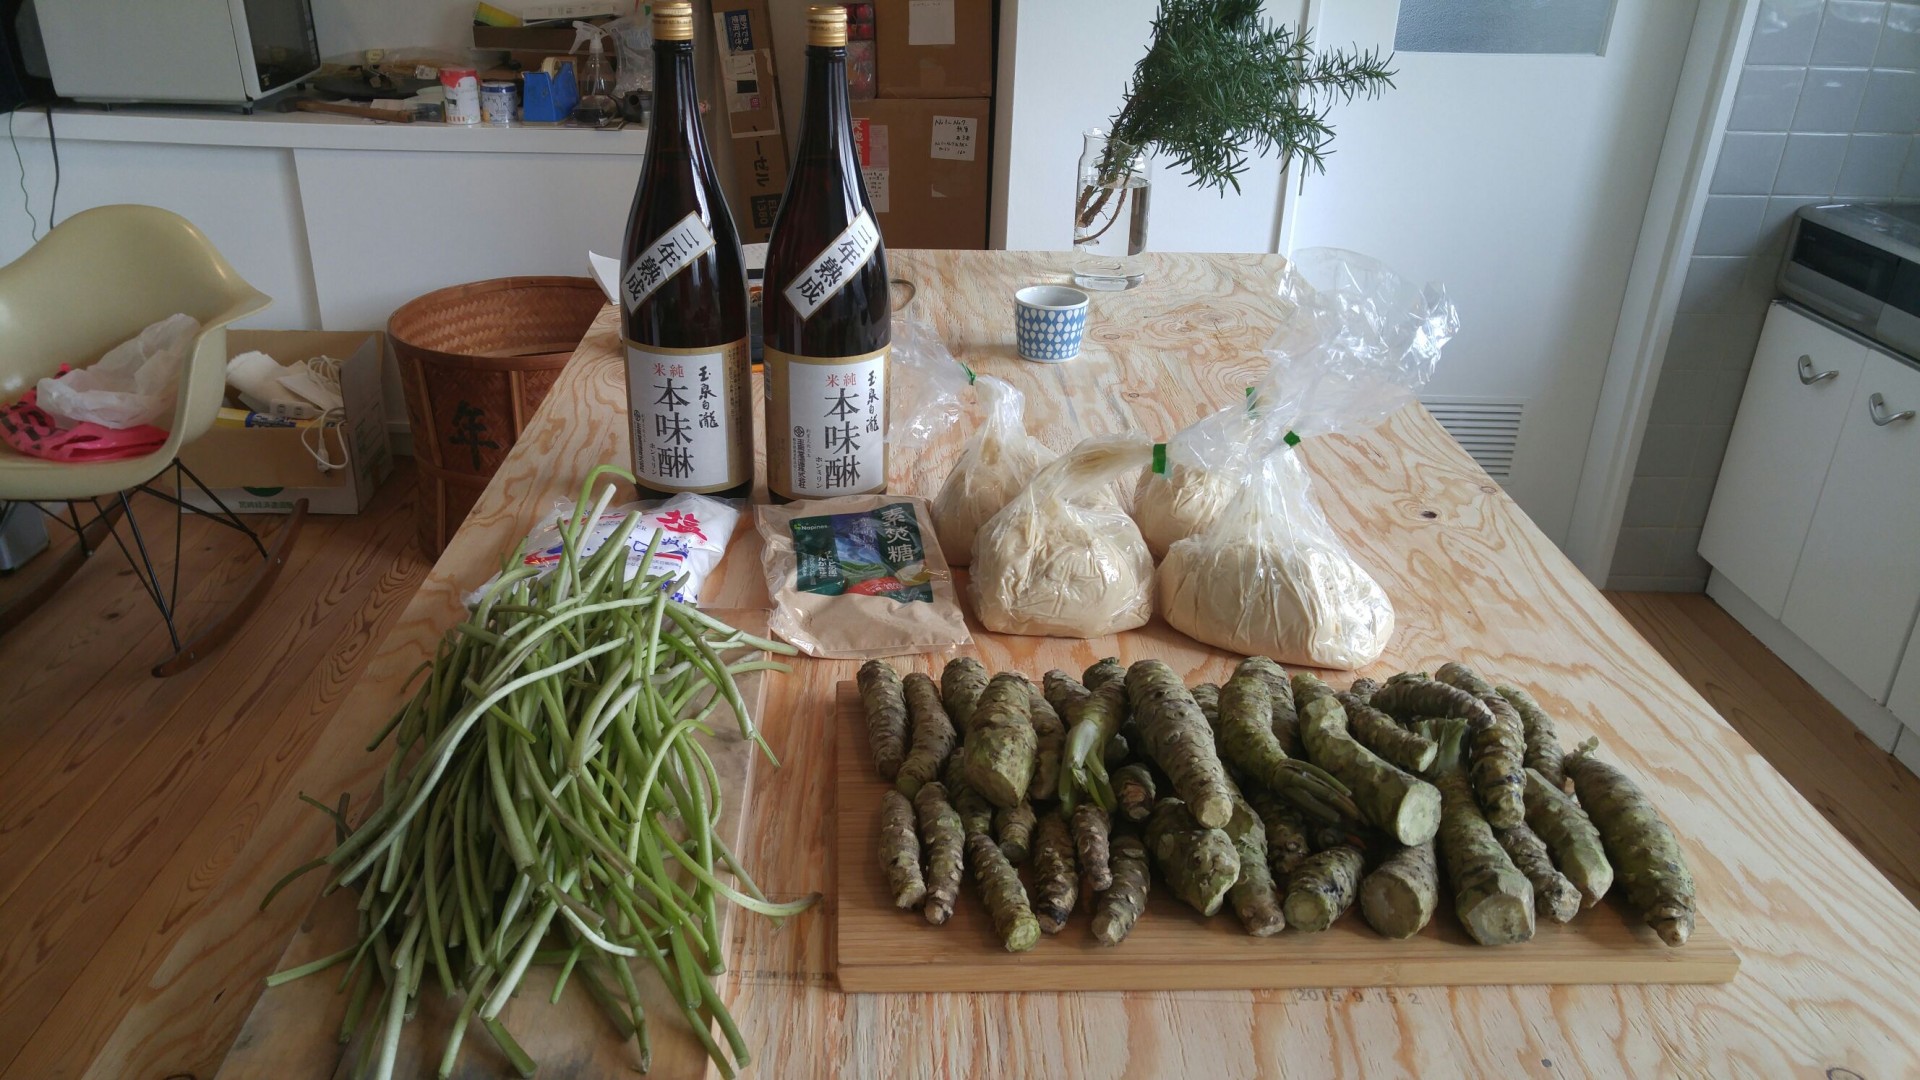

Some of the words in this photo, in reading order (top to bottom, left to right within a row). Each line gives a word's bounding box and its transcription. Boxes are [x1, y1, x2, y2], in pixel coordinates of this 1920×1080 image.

[625, 227, 700, 302] 三年熟成
[796, 224, 873, 306] 三年熟成
[447, 399, 500, 472] 年
[652, 378, 695, 479] 本味醂
[824, 388, 861, 490] 本味醂
[656, 510, 708, 541] 塩
[881, 507, 914, 563] 素焚糖
